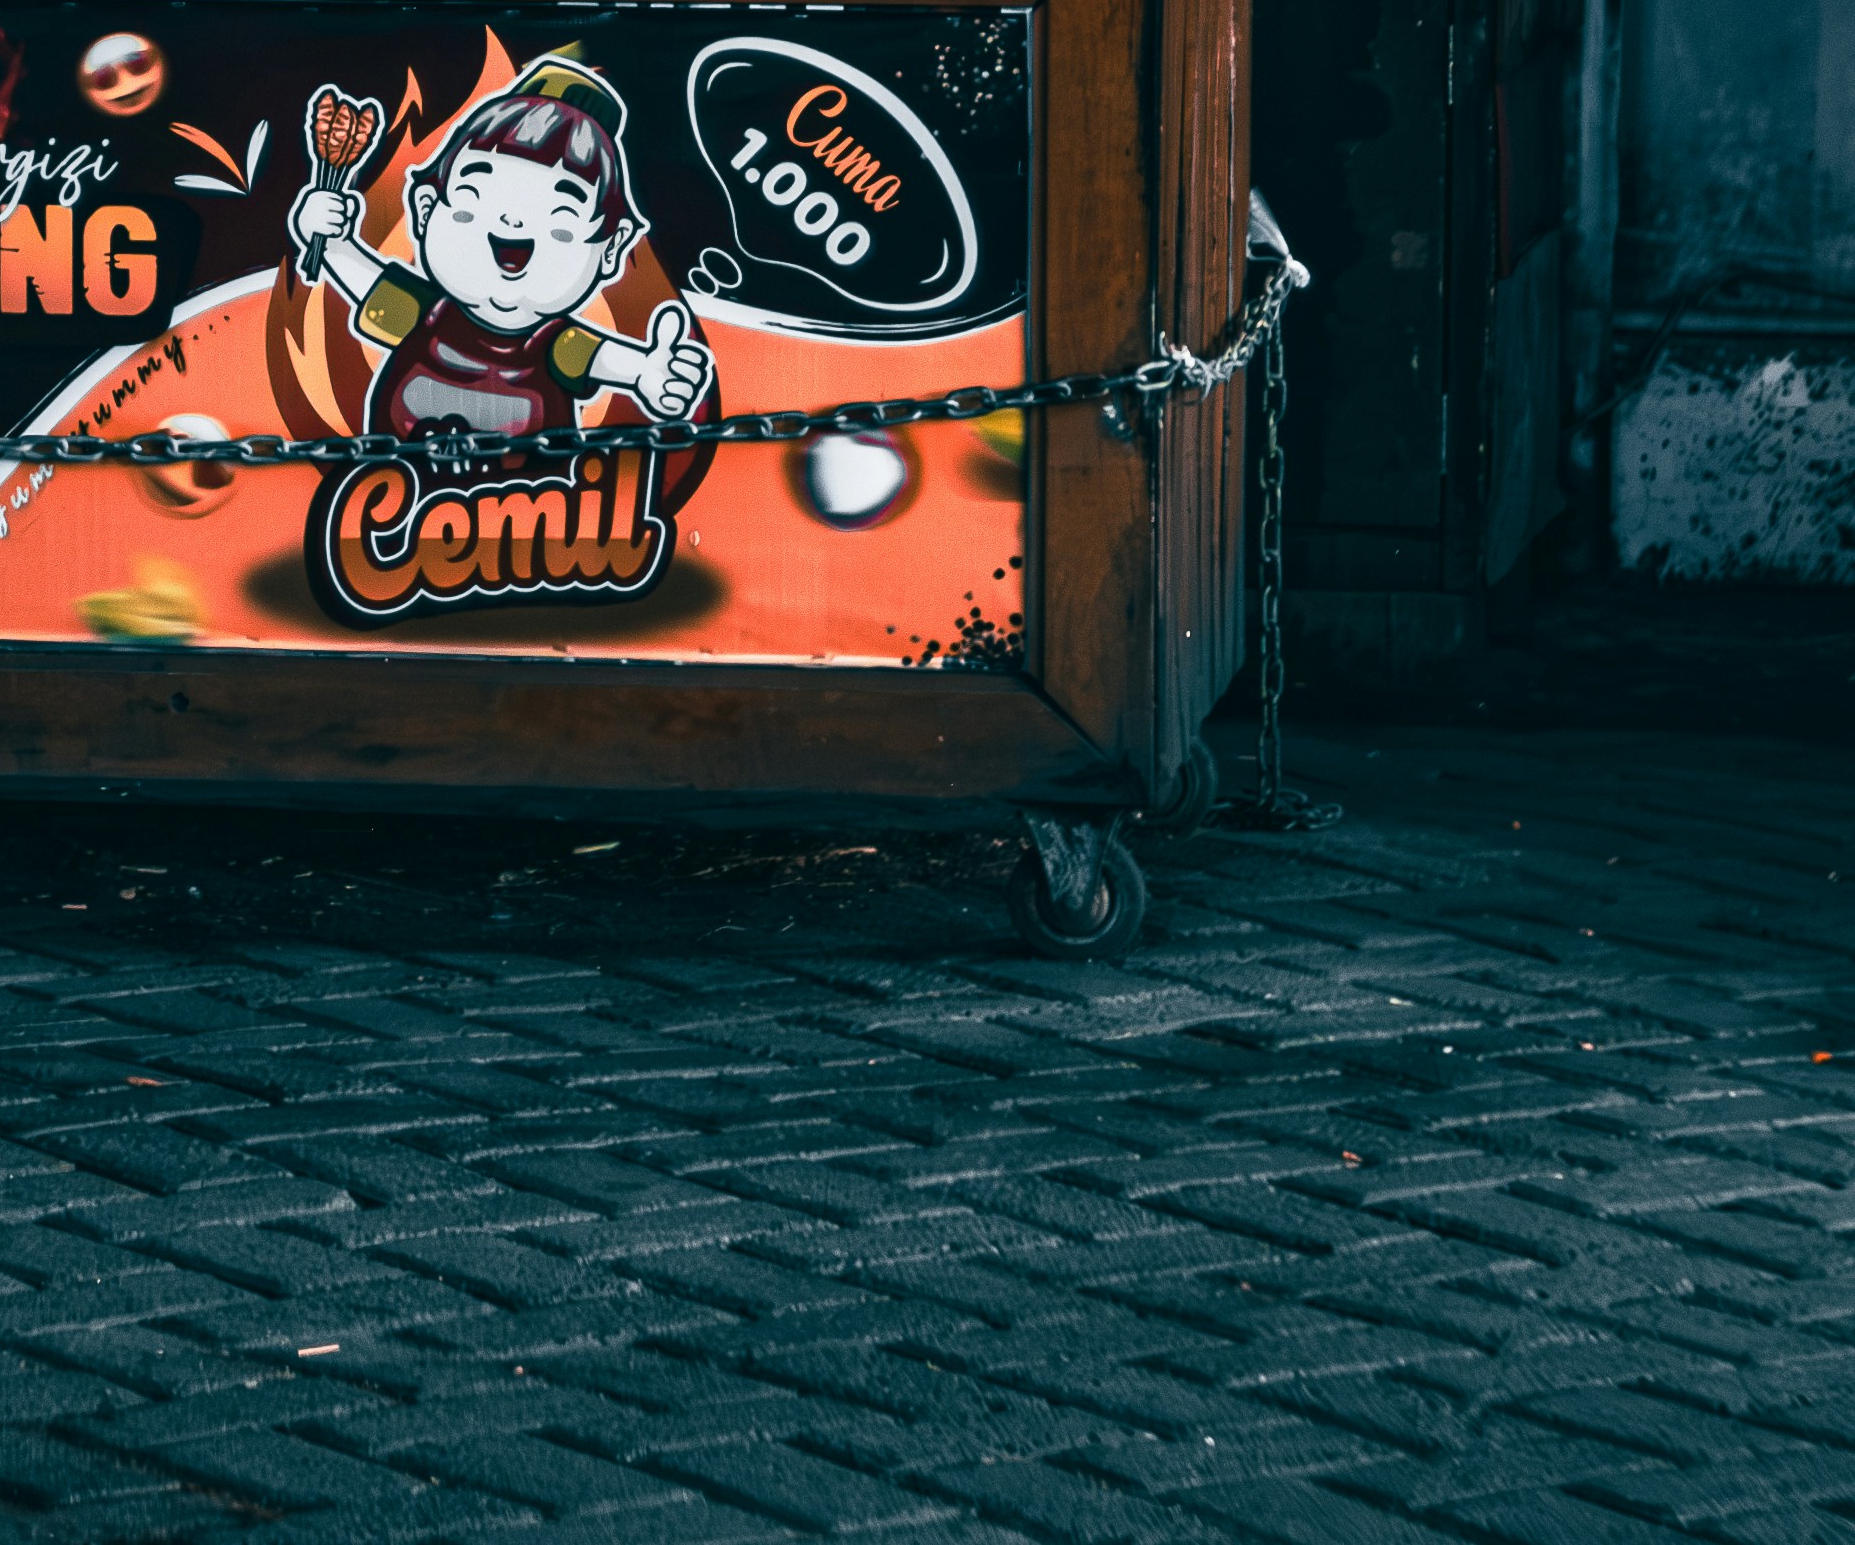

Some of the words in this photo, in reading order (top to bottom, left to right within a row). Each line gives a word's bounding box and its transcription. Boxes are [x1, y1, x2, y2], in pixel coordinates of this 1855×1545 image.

[730, 127, 871, 266] 1.000
[785, 84, 902, 213] Cuma
[340, 447, 653, 603] Cemil
